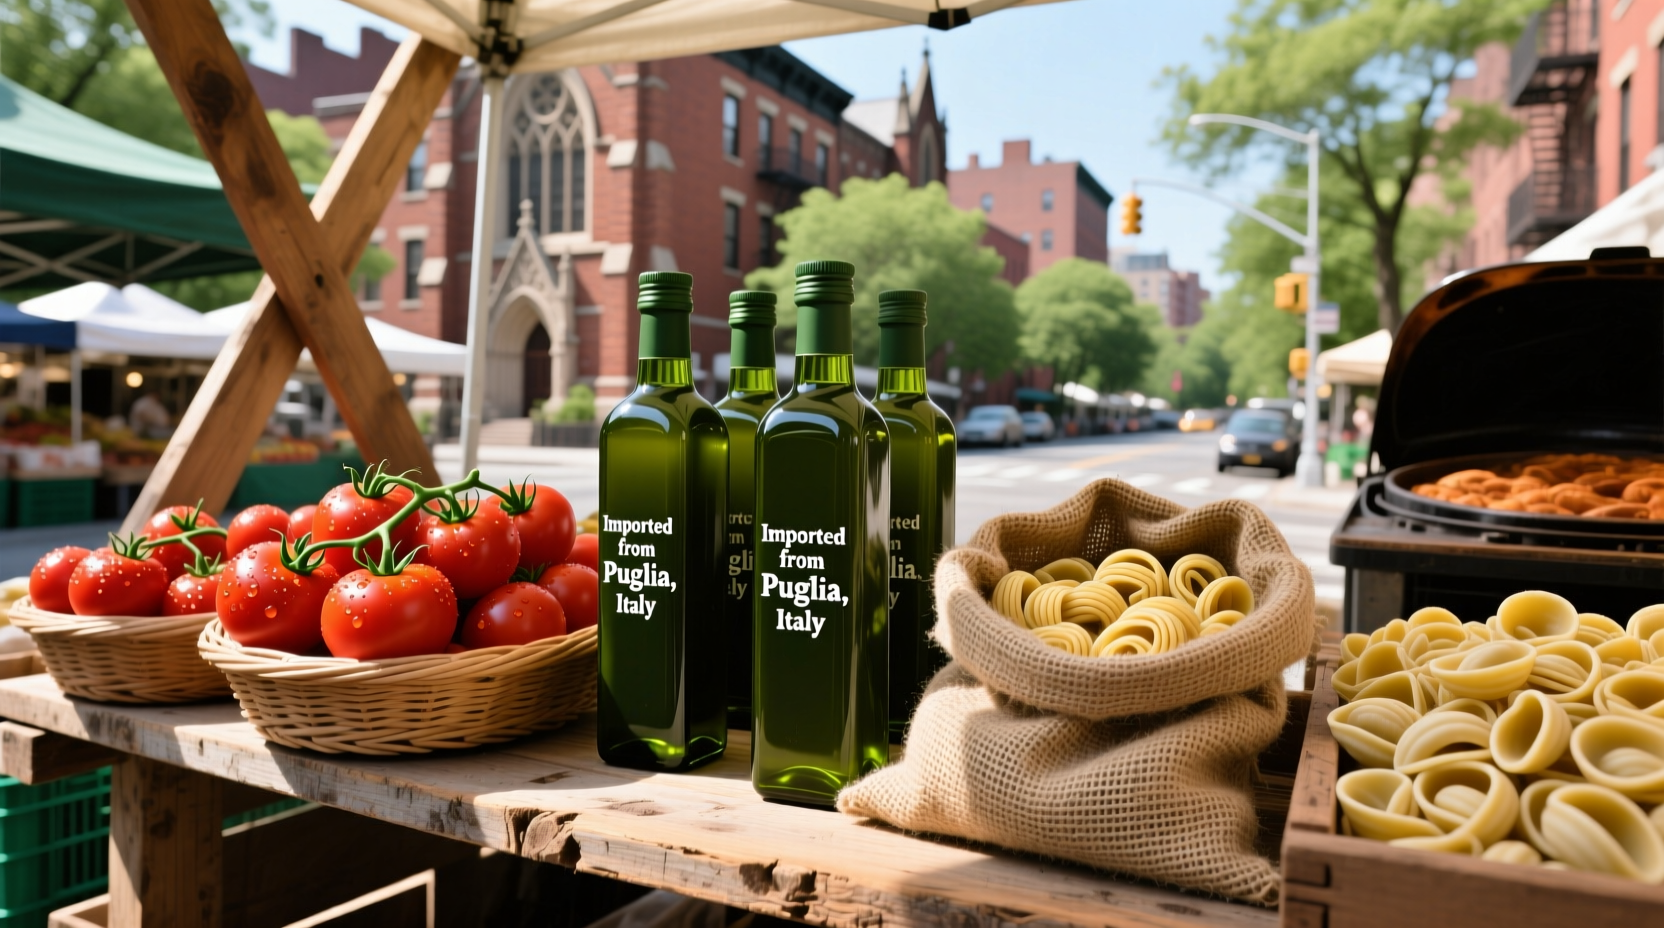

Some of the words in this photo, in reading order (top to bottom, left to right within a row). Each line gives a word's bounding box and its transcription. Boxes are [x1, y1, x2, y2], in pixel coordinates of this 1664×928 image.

[602, 514, 673, 537] Imported
[761, 523, 846, 548] Imported
[618, 537, 656, 557] from
[779, 548, 825, 570] from
[603, 560, 677, 592] Puglia,
[760, 572, 849, 607] Puglia,
[616, 593, 657, 621] Italy
[776, 608, 826, 639] Italy
